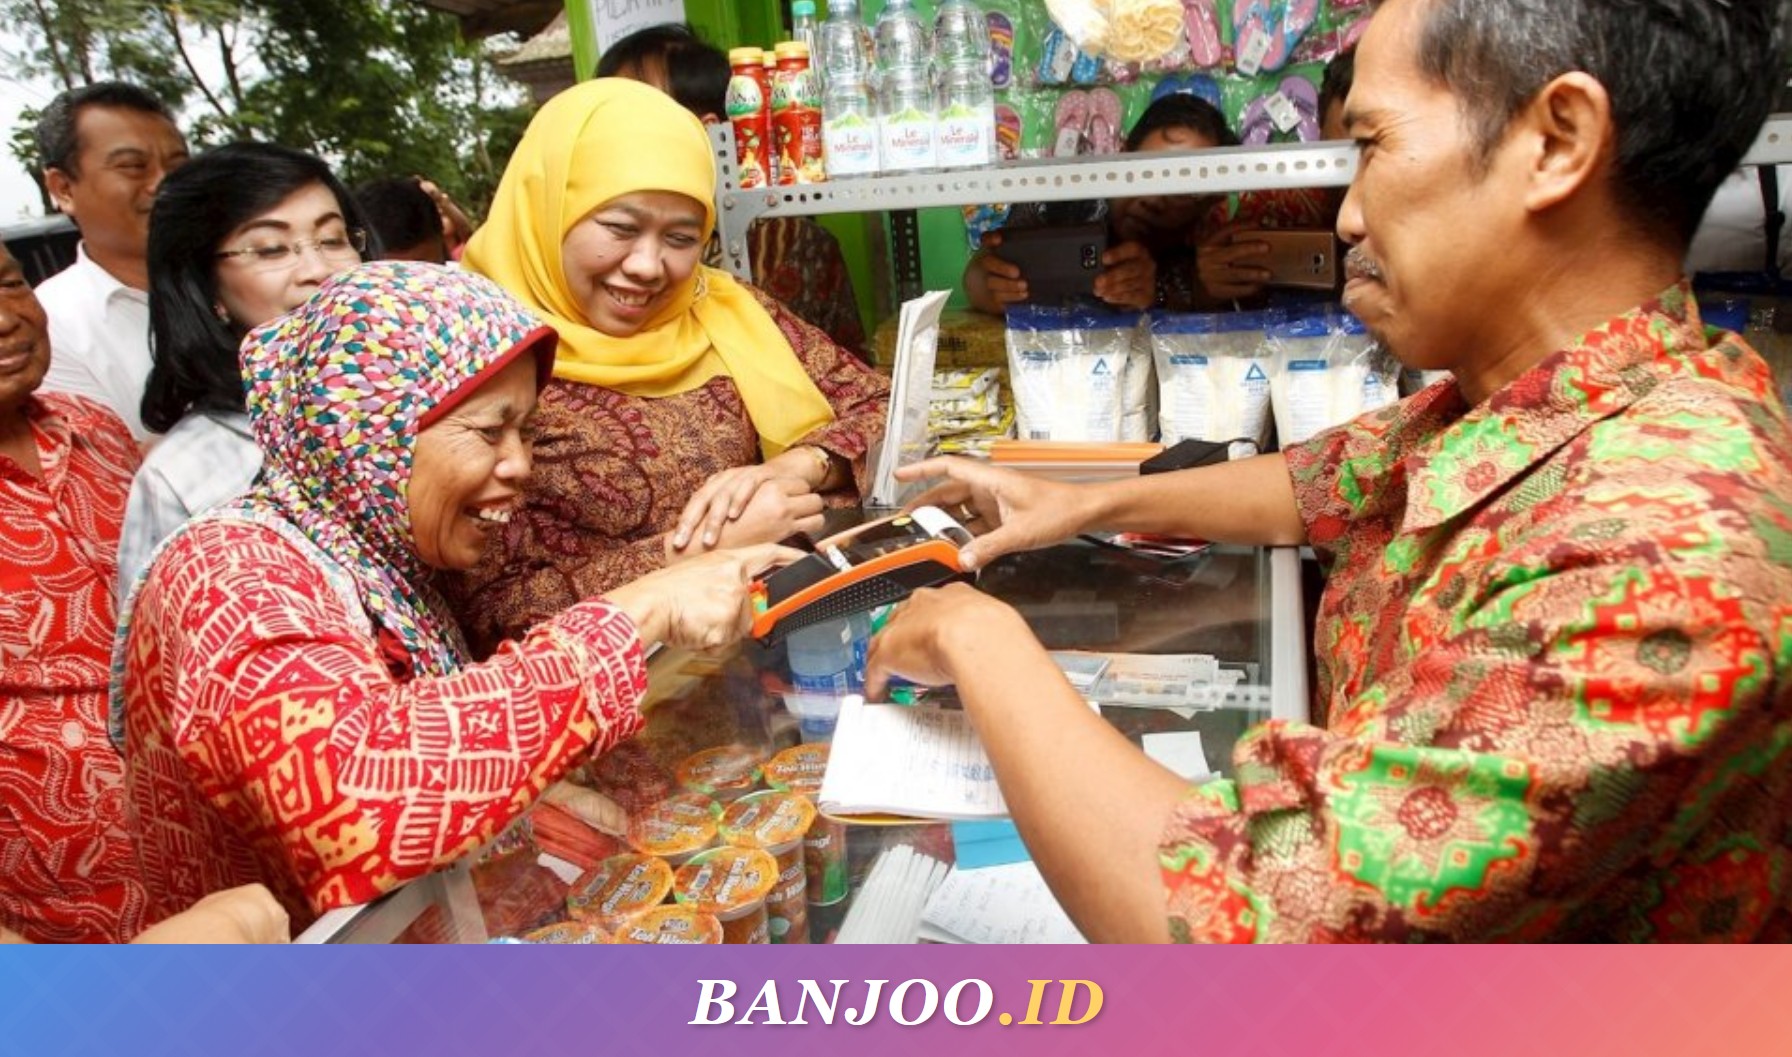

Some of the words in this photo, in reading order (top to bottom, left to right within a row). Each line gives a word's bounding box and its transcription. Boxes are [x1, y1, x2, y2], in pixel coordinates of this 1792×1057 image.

[905, 128, 918, 138] Le
[949, 124, 963, 136] Le
[846, 132, 860, 144] Le
